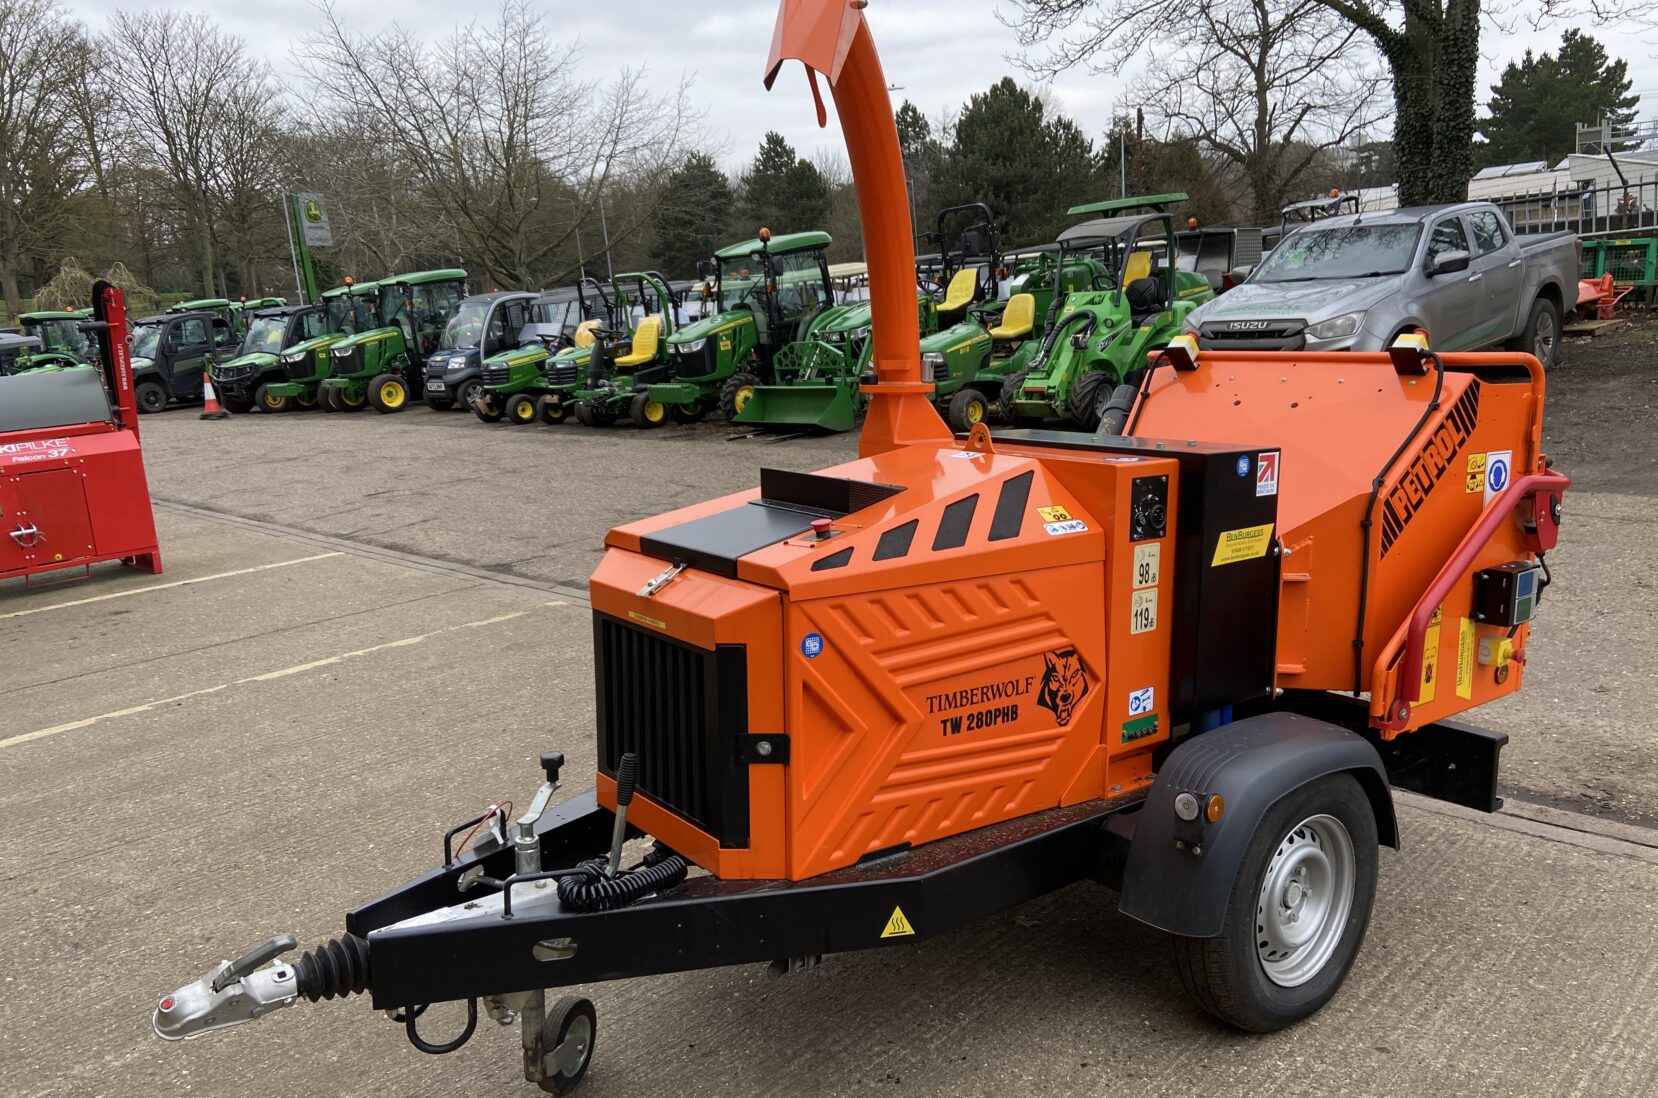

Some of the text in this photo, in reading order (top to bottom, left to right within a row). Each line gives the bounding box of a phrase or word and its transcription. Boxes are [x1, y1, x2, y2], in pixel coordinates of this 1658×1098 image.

[1229, 321, 1268, 330] ISUZU
[12, 448, 68, 463] Falcon 37
[1391, 416, 1468, 523] PETROL
[1138, 562, 1150, 585] 98
[1133, 607, 1150, 630] 119
[926, 676, 1035, 714] TIMBERWOLF
[940, 704, 1019, 737] TW 280PHB
